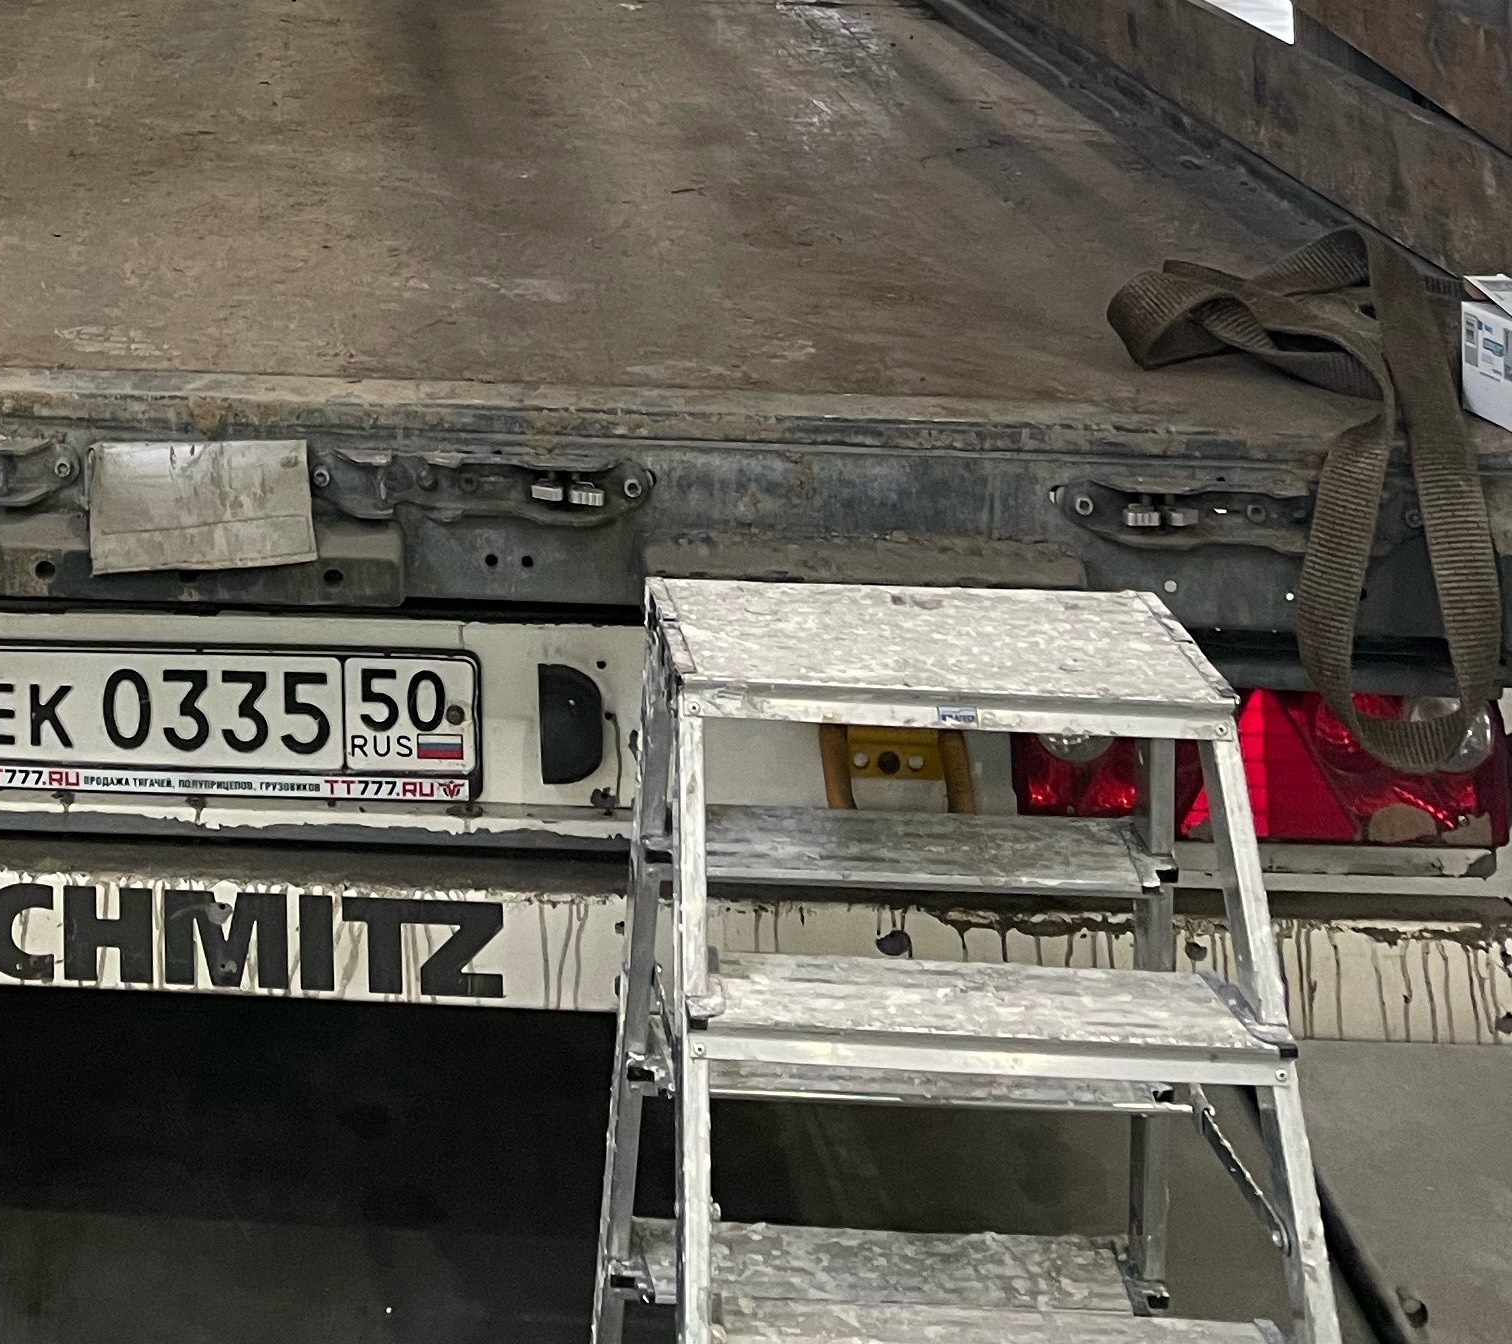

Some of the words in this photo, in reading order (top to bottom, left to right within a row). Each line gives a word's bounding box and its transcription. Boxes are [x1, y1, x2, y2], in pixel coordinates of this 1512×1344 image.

[102, 668, 330, 755] 0335
[360, 667, 446, 732] 50
[350, 733, 414, 759] RUS
[83, 775, 131, 787] ПРОДАЖА
[133, 776, 175, 789] ТЯГАЧЕЙ,
[178, 779, 256, 792] ПОЛУПРИЦЕПОВ,
[259, 781, 321, 793] ГРУЗОВИКОВ
[326, 779, 436, 799] TT777.RU
